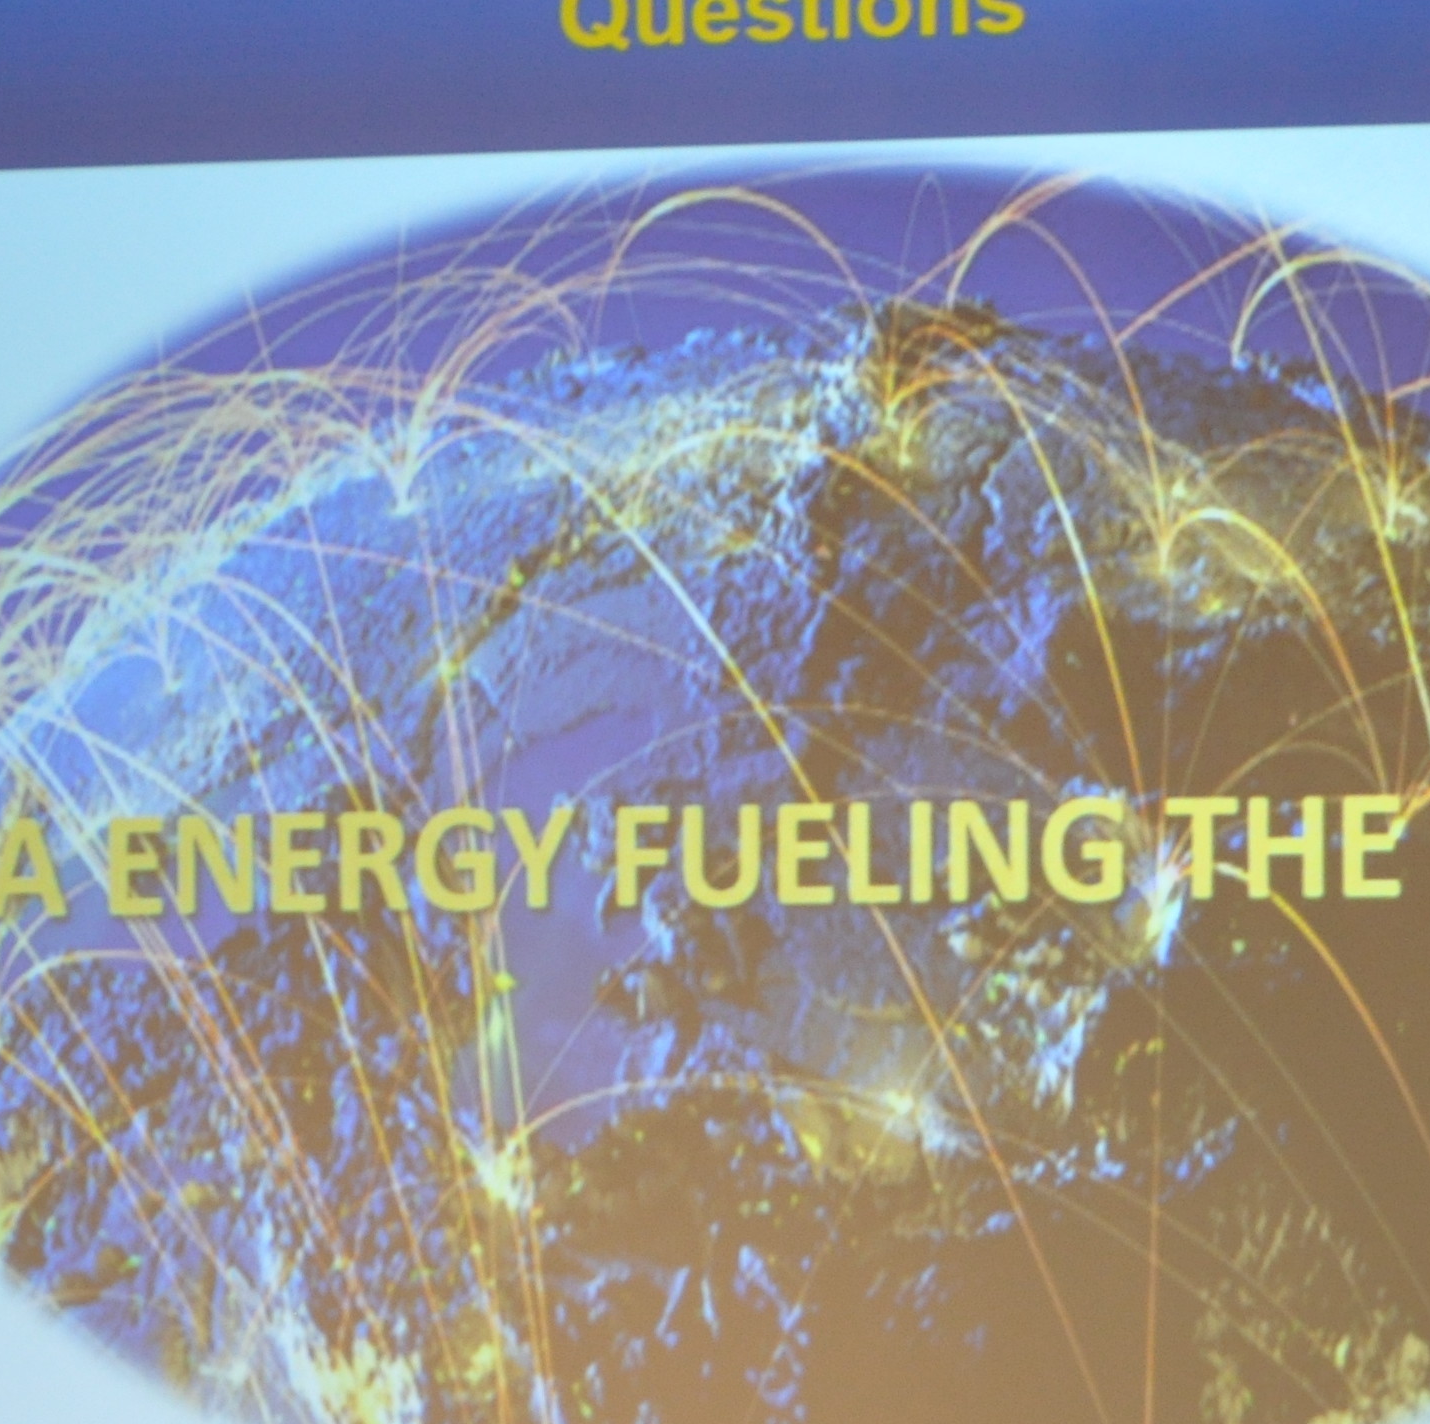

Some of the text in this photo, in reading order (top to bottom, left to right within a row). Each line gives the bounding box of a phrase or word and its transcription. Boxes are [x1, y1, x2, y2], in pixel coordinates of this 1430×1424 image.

[559, 0, 1027, 50] Questions
[107, 805, 574, 917] ENERGY
[614, 796, 1126, 909] FUELING
[1164, 795, 1402, 899] THE
